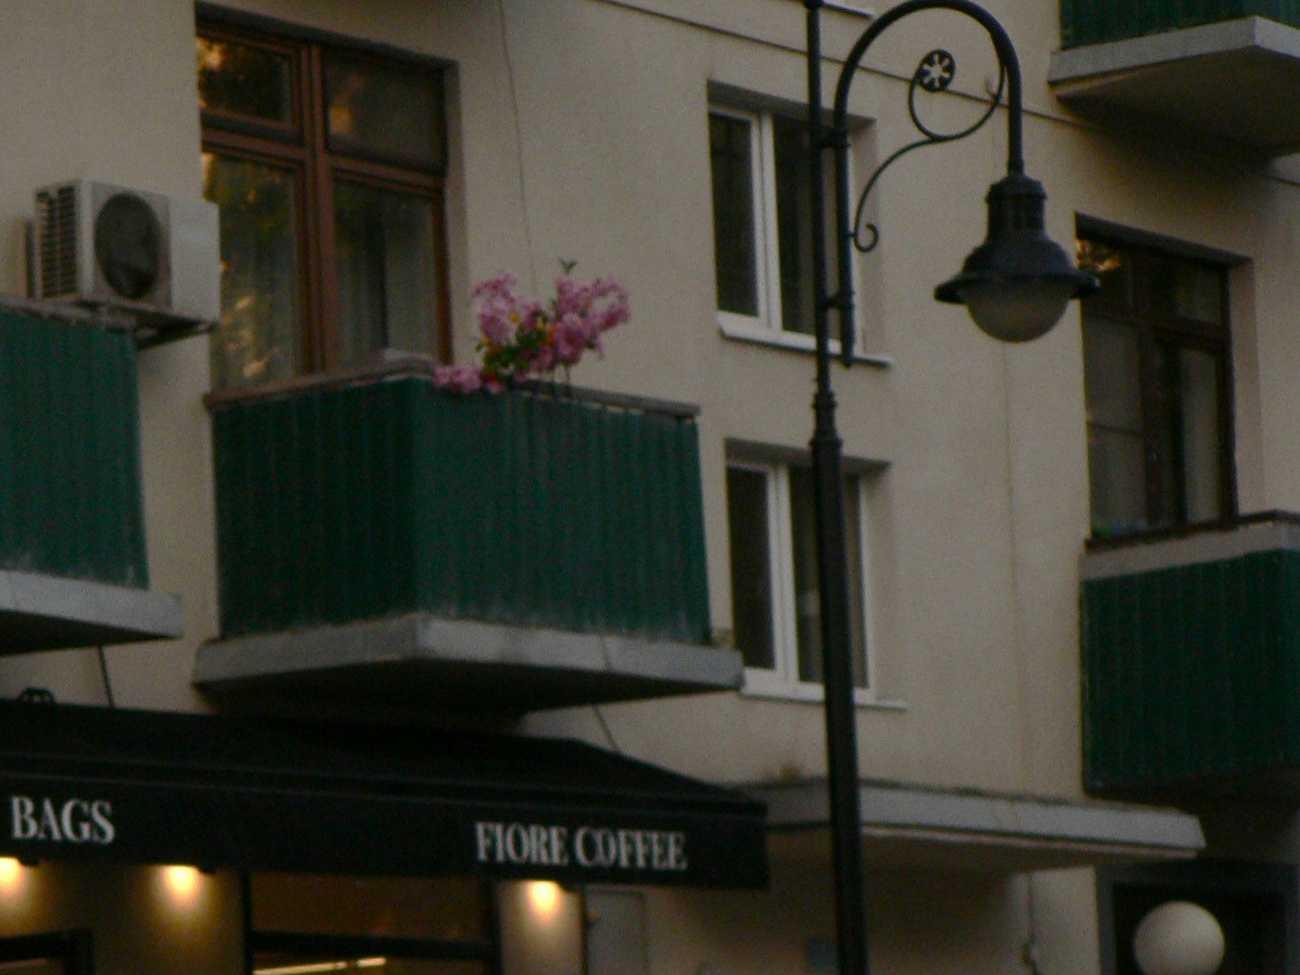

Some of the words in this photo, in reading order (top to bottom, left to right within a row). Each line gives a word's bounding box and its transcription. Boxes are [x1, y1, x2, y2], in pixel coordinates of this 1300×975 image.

[10, 795, 115, 844] BAGS
[475, 821, 569, 867] FIORE
[573, 826, 688, 871] COFFEE
